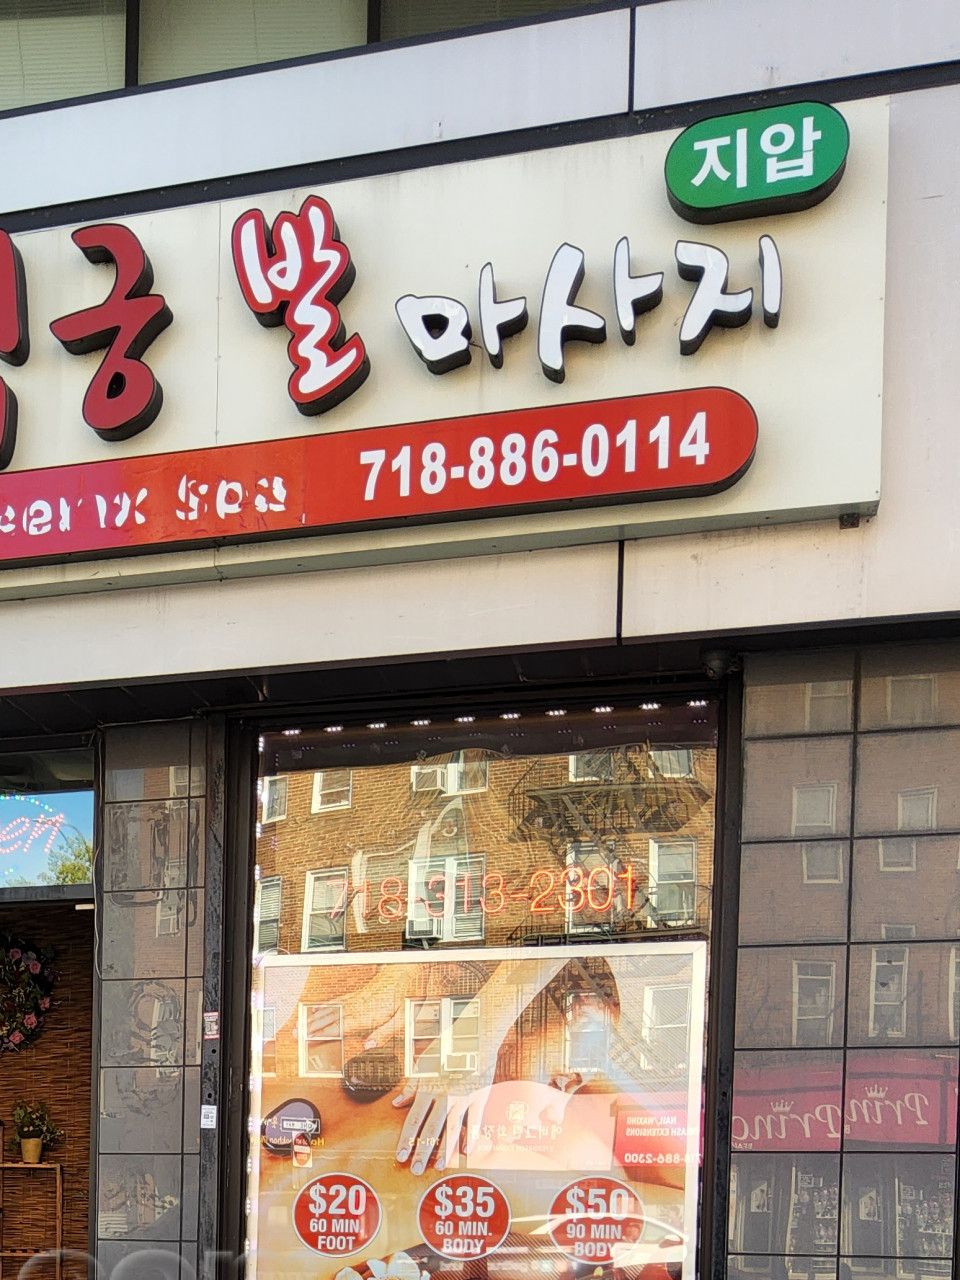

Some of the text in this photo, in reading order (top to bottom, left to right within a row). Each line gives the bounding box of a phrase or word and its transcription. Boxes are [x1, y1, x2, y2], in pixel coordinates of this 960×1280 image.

[691, 116, 822, 189] 지압
[231, 195, 365, 408] 발
[395, 235, 784, 380] 마사지
[359, 412, 710, 501] 718-886-0114
[326, 862, 637, 919] 718-313-2301
[308, 1183, 629, 1222] $20 $35 $50
[309, 1218, 326, 1233] 60
[435, 1221, 453, 1236] 60
[458, 1222, 492, 1237] MIN.
[566, 1223, 585, 1239] 90
[317, 1236, 615, 1257] FOOT BODY BODY
